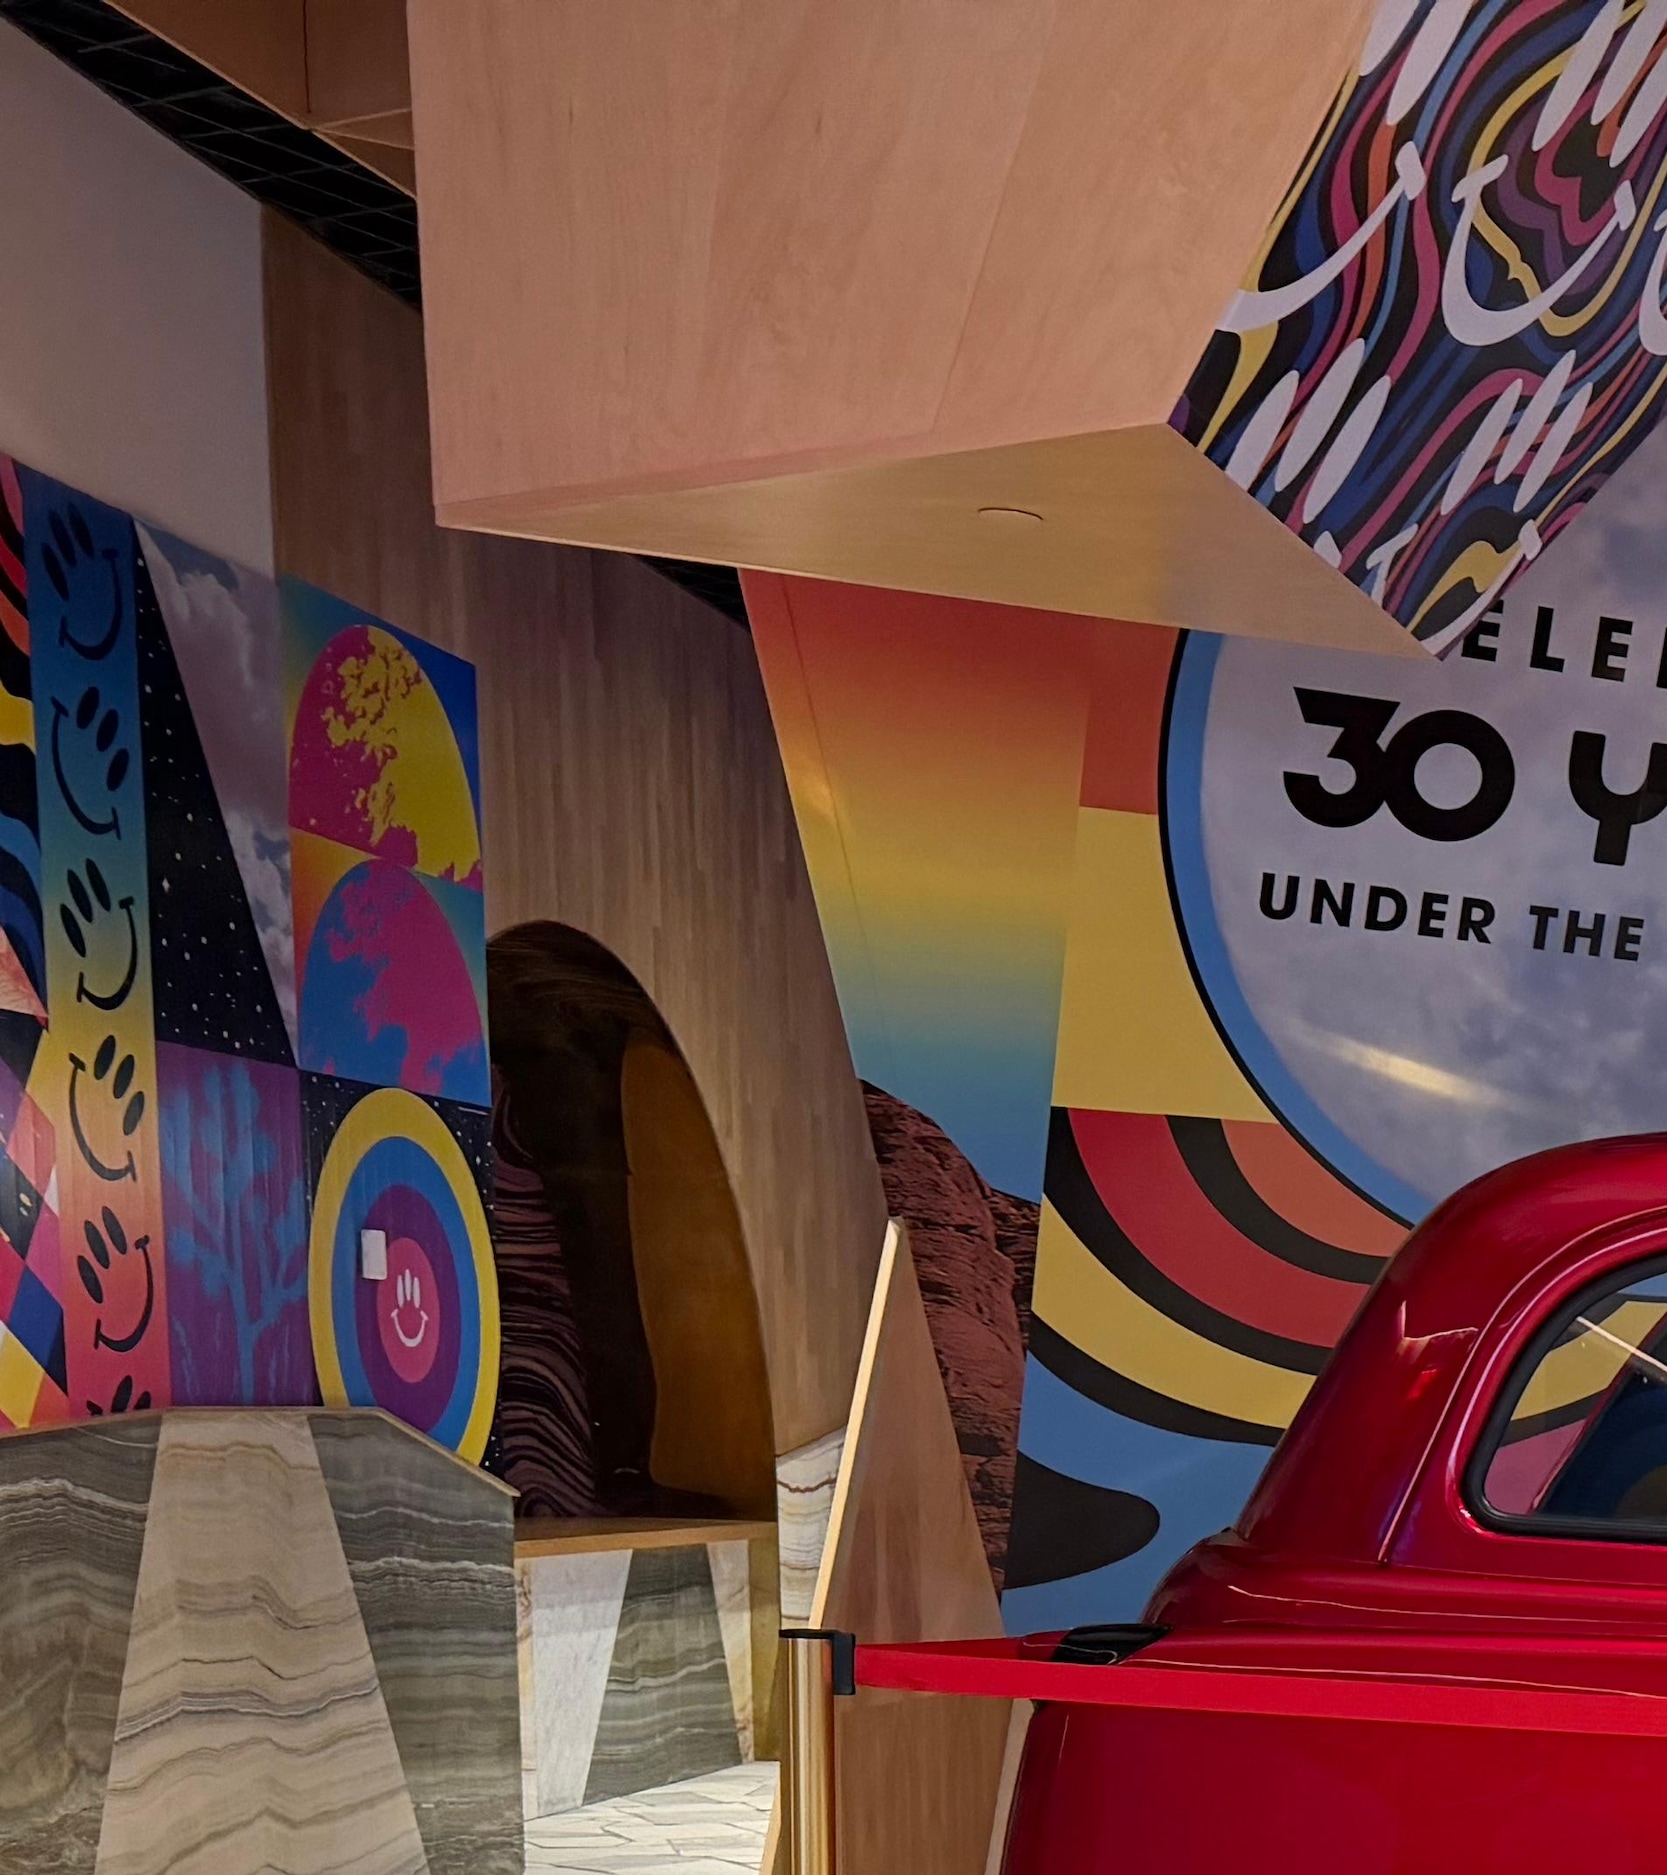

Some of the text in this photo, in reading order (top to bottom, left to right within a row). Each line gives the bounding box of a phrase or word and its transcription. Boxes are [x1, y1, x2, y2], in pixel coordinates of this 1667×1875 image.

[1282, 685, 1516, 843] 30
[1258, 871, 1496, 946] UNDER
[1528, 904, 1645, 963] THE
